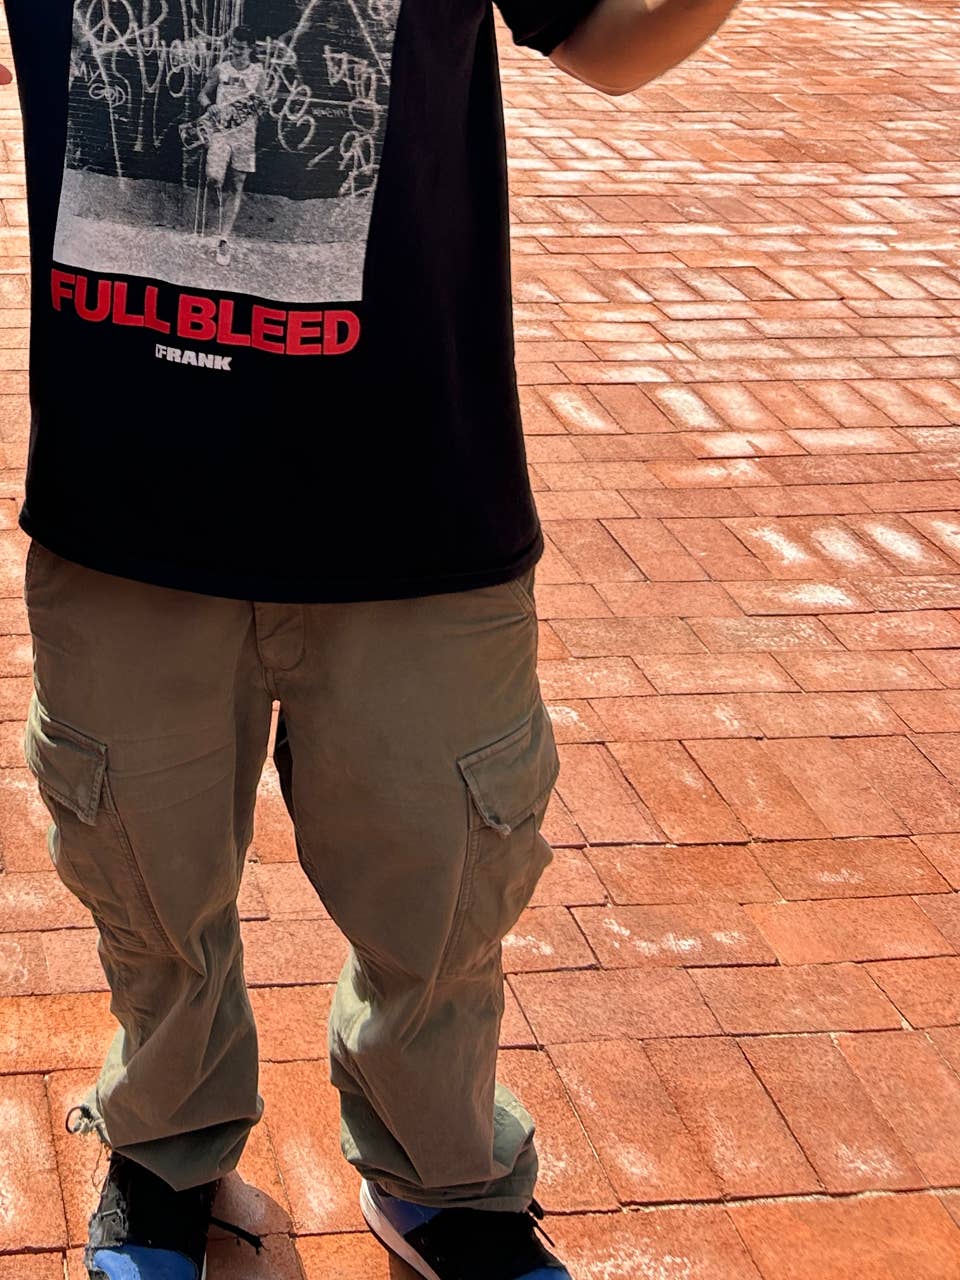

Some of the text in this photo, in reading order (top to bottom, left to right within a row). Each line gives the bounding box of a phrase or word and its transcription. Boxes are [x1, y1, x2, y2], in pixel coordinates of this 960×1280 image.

[50, 268, 361, 356] FULL BLEED
[155, 343, 233, 371] FRANK
